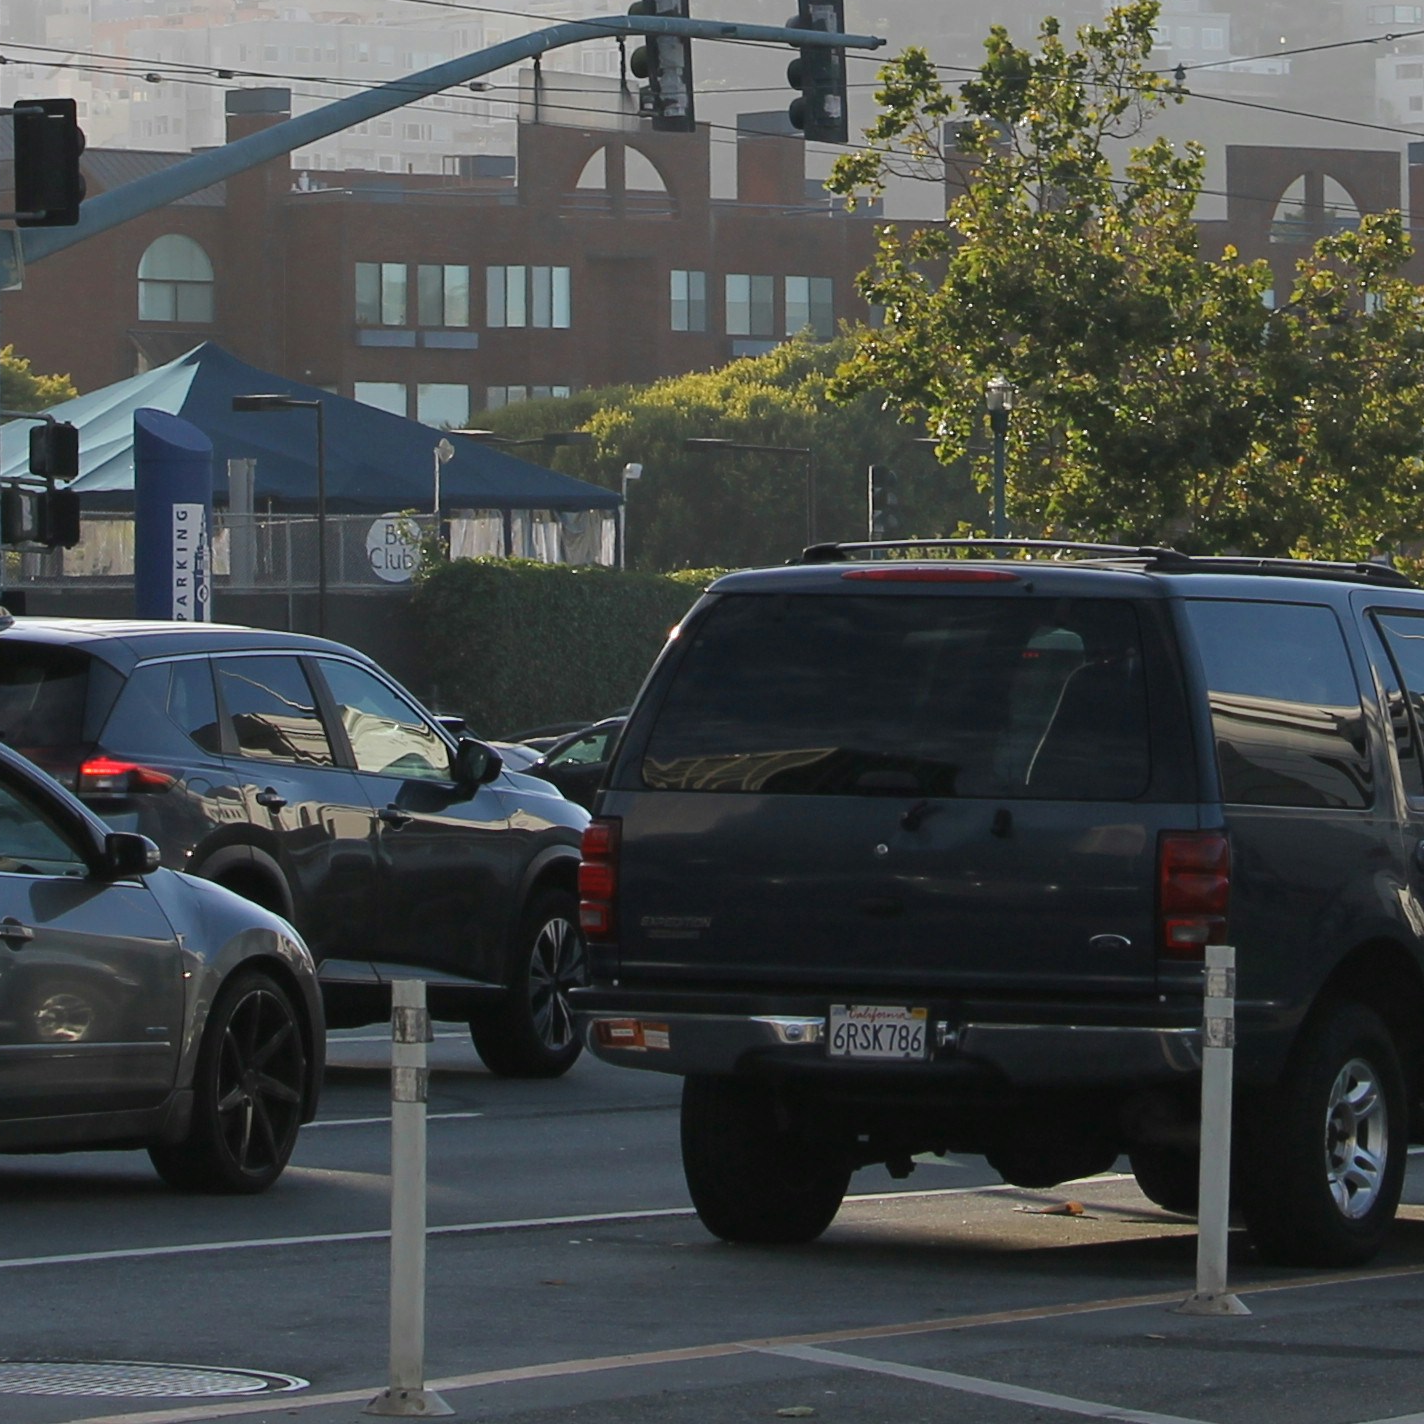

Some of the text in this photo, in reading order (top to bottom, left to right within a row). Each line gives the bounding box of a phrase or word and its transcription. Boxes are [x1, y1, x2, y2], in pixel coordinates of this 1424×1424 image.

[177, 510, 188, 621] PARKING
[369, 547, 414, 570] Club
[849, 1006, 906, 1023] California
[834, 1023, 923, 1052] 6RSK786
